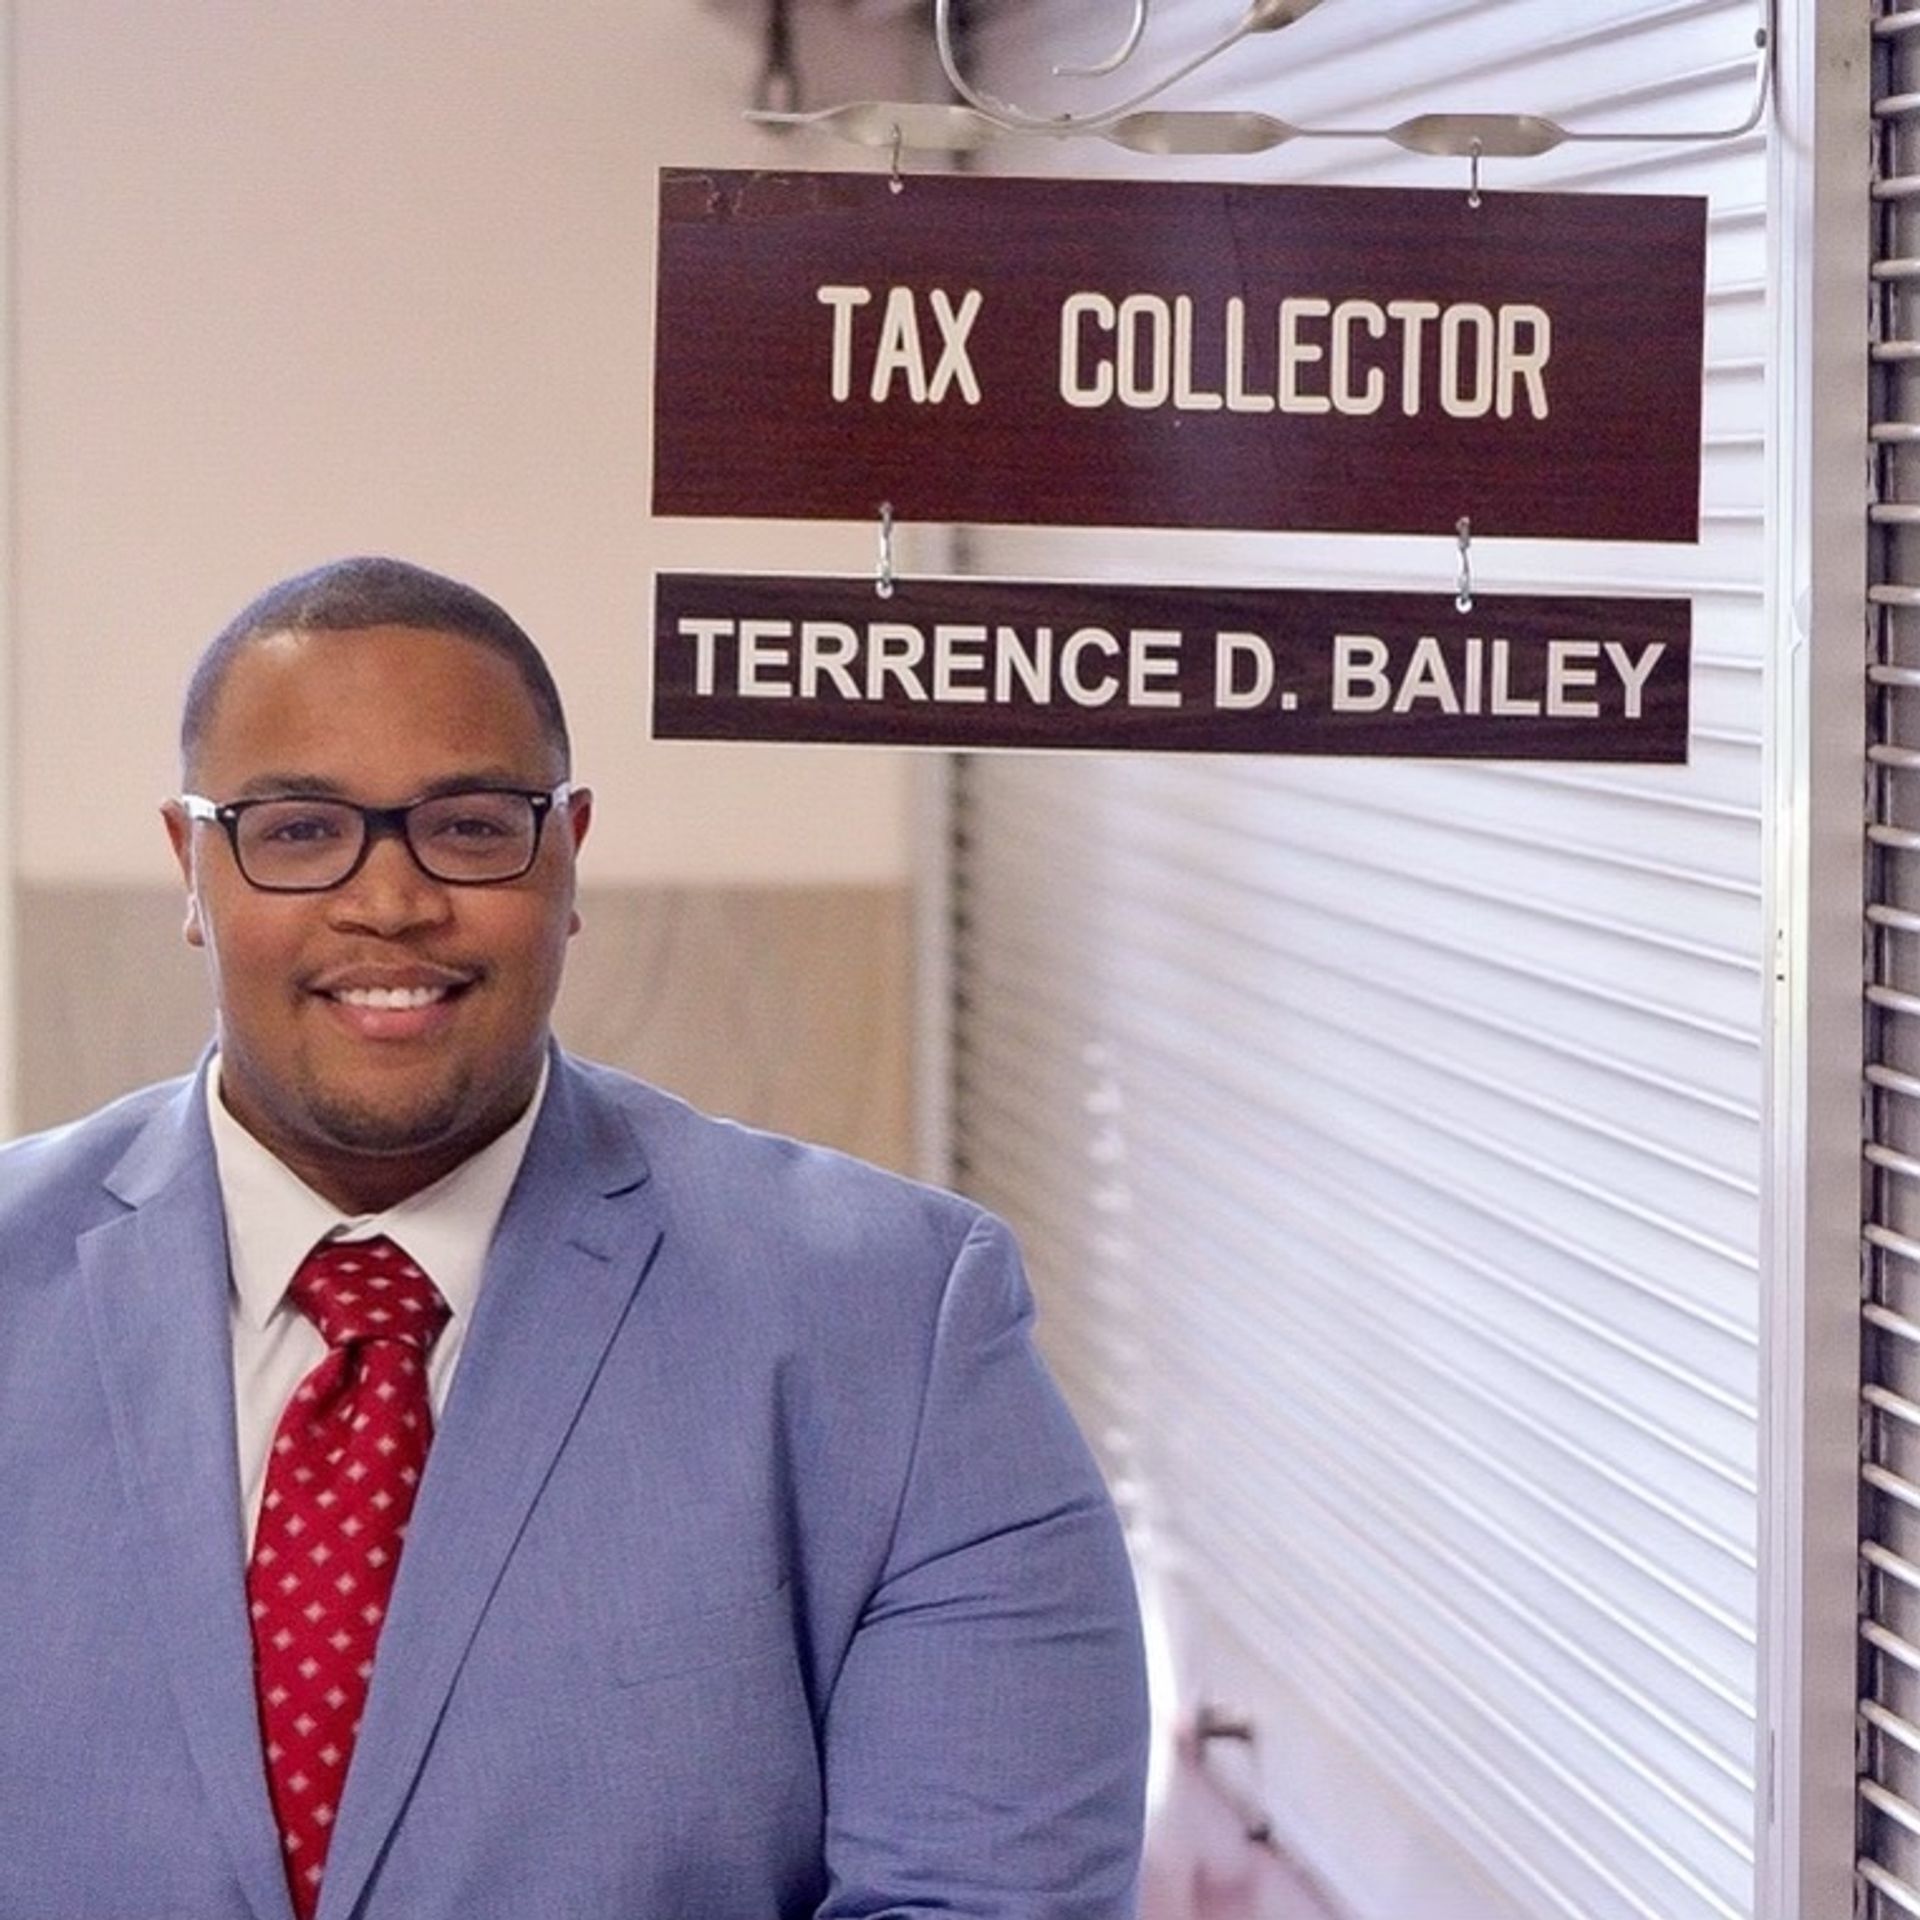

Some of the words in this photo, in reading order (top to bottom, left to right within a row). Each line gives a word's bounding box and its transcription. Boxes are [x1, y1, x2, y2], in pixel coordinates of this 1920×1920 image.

[816, 285, 983, 406] TAX
[1059, 292, 1552, 421] COLLECTOR
[677, 617, 1183, 709] TERRENCE
[1214, 631, 1298, 711] D.
[1331, 634, 1667, 720] BAILEY
